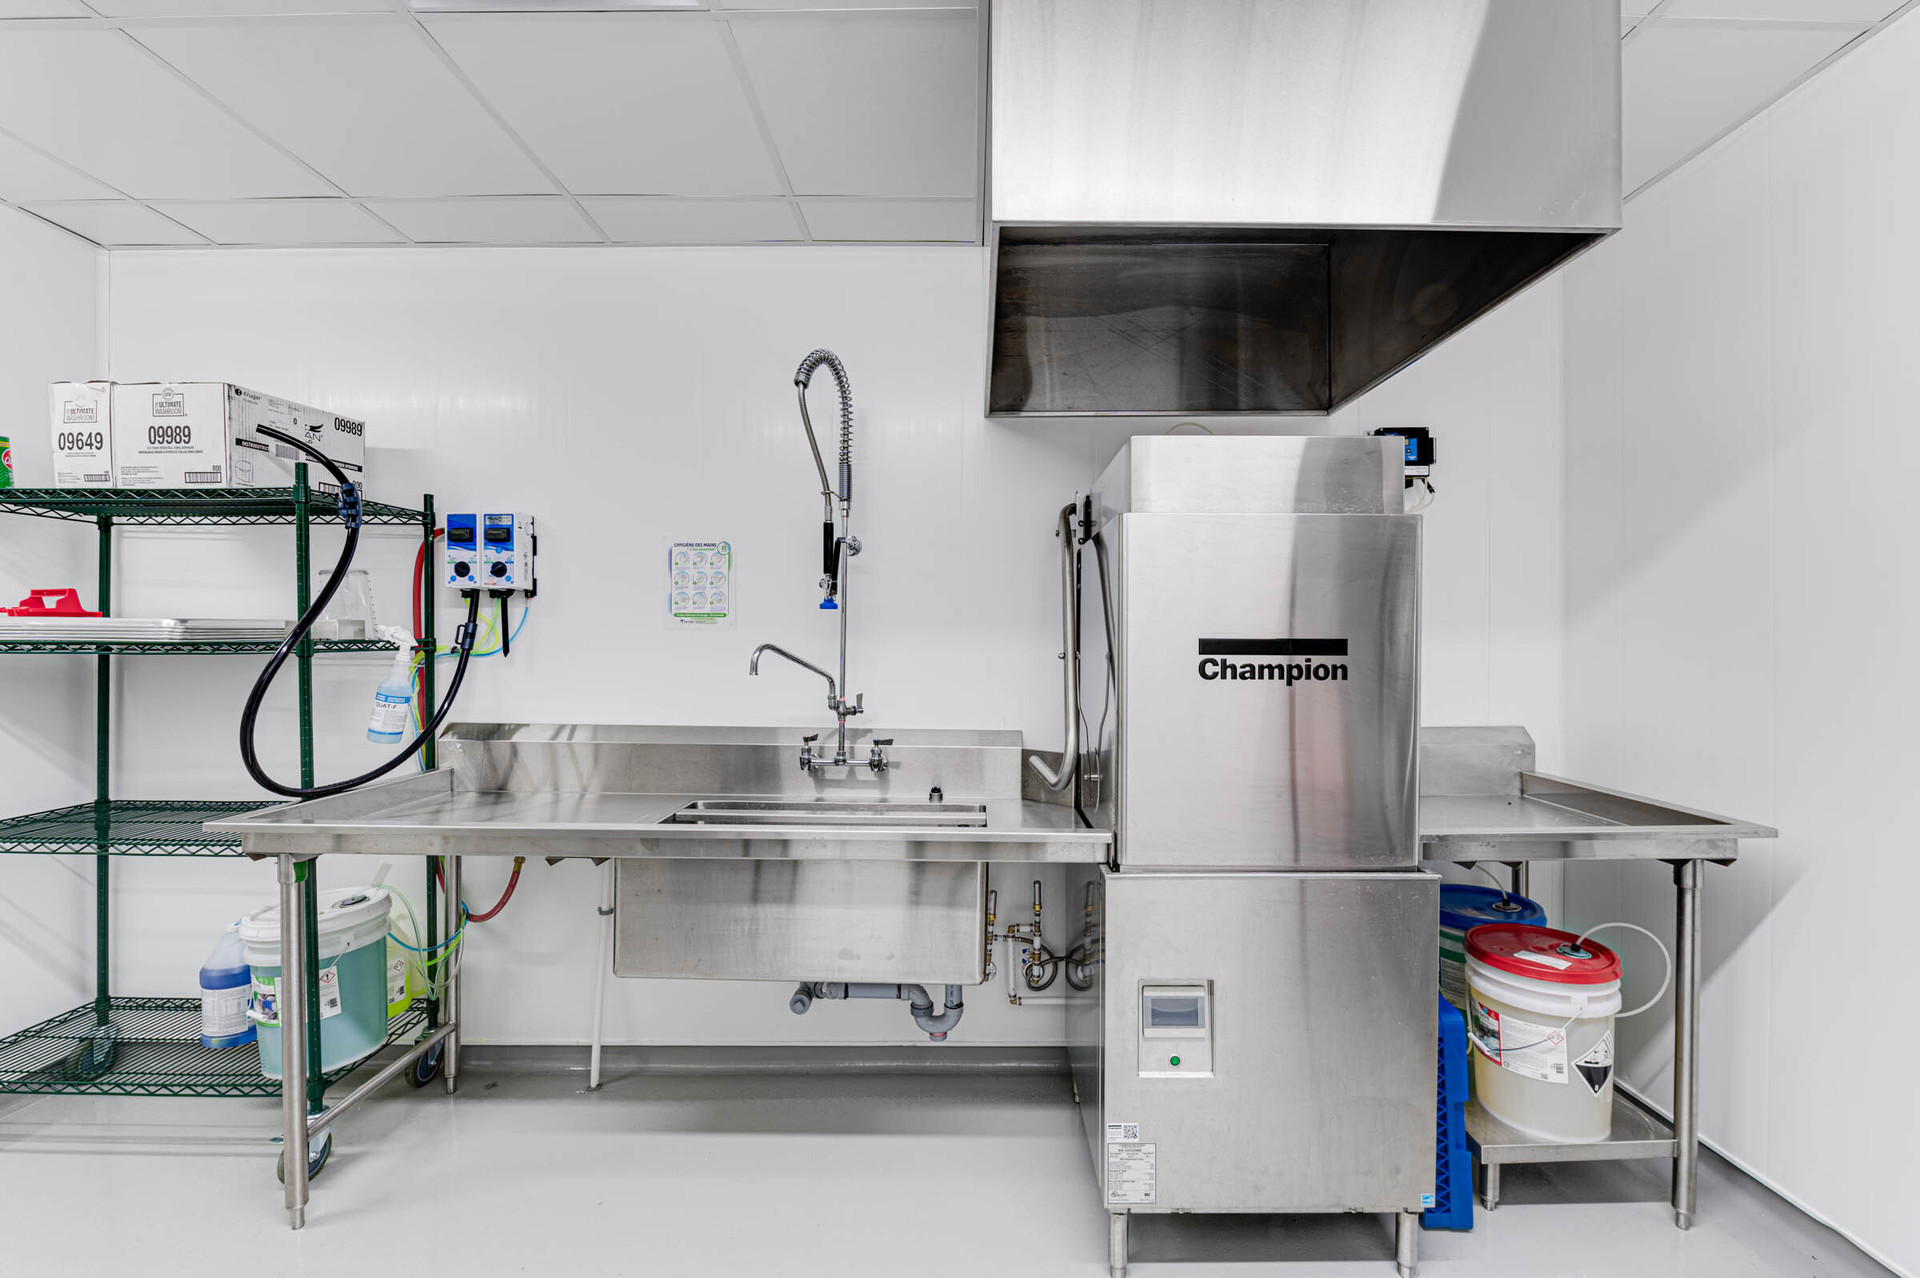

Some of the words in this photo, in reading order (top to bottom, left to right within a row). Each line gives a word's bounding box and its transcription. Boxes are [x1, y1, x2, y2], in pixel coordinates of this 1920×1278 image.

[243, 390, 261, 401] Kruger
[148, 425, 192, 445] 09989
[334, 417, 363, 437] 09989
[58, 431, 104, 451] 09649
[1198, 657, 1349, 687] Champion
